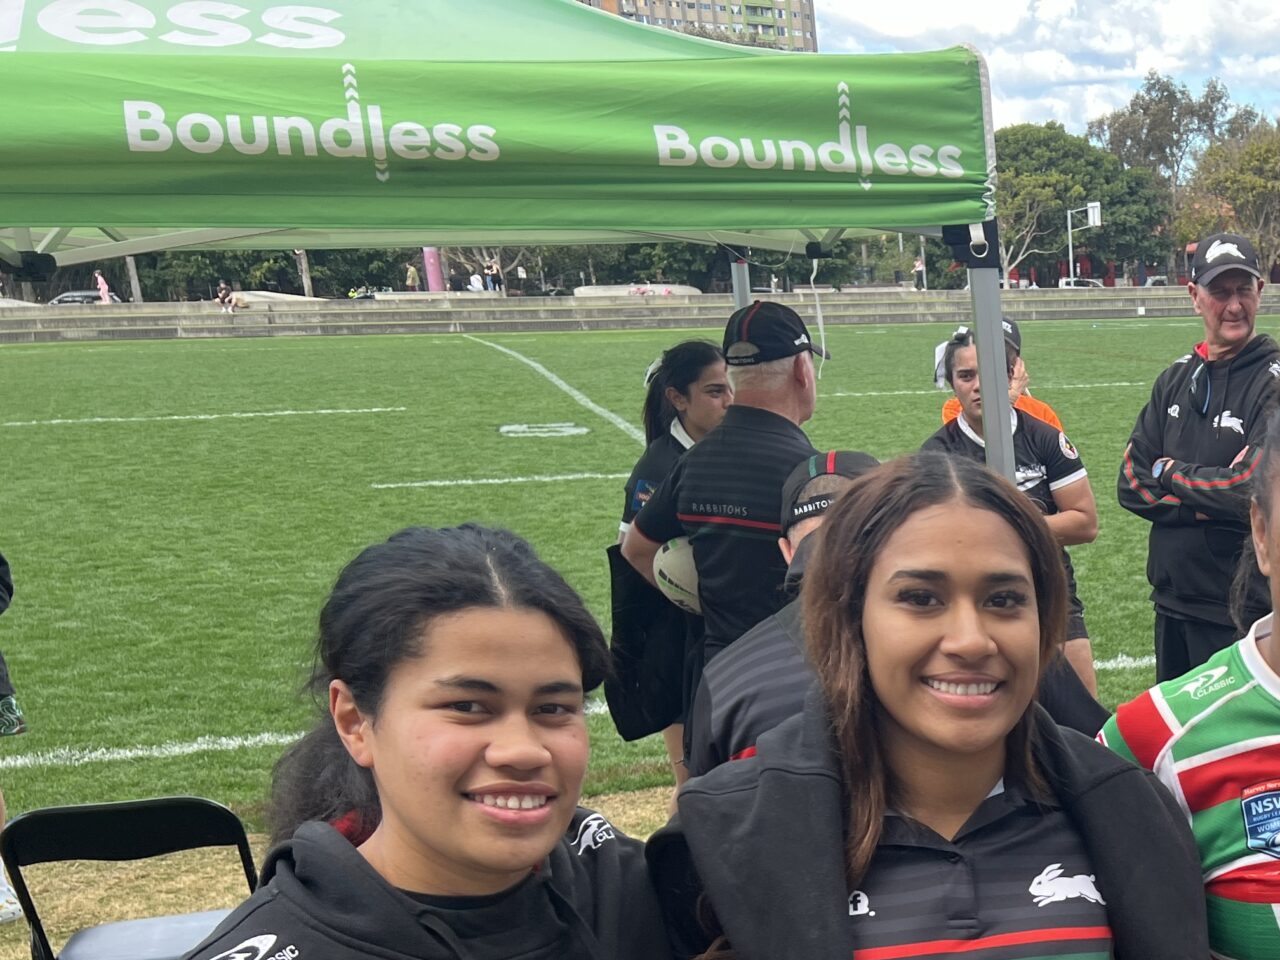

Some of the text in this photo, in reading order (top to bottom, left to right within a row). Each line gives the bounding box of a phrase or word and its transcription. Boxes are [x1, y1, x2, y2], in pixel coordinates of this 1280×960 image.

[123, 97, 501, 165] Boundless
[652, 120, 965, 180] Boundless
[692, 502, 748, 517] RABBITOHS
[1197, 676, 1236, 698] CLASSIC
